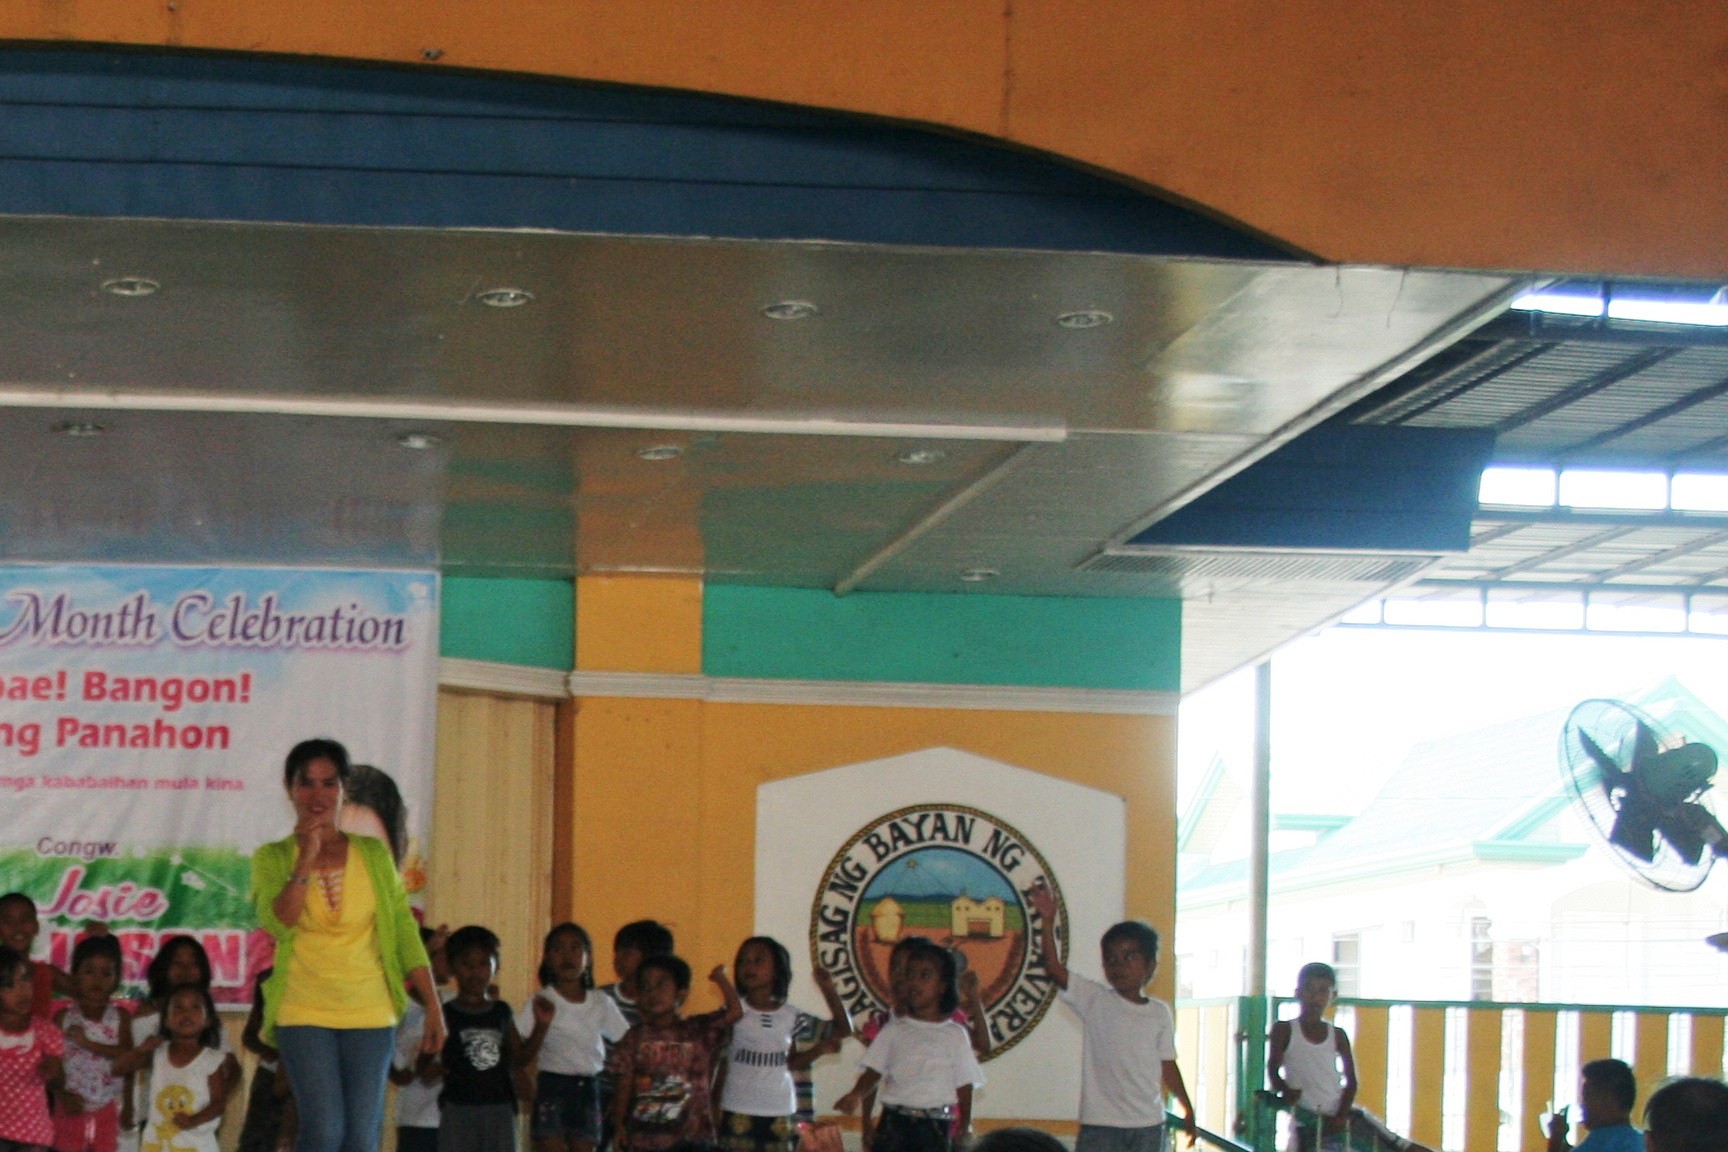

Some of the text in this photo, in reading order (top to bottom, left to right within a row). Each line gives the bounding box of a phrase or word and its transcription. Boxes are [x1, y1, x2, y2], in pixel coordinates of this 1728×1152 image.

[173, 593, 406, 648] Celebration
[82, 671, 252, 711] Bangon!
[55, 717, 230, 750] Panahon
[829, 857, 869, 904] NG
[861, 812, 976, 864] BAYAN
[982, 828, 1026, 873] NG
[36, 867, 167, 919] Josie
